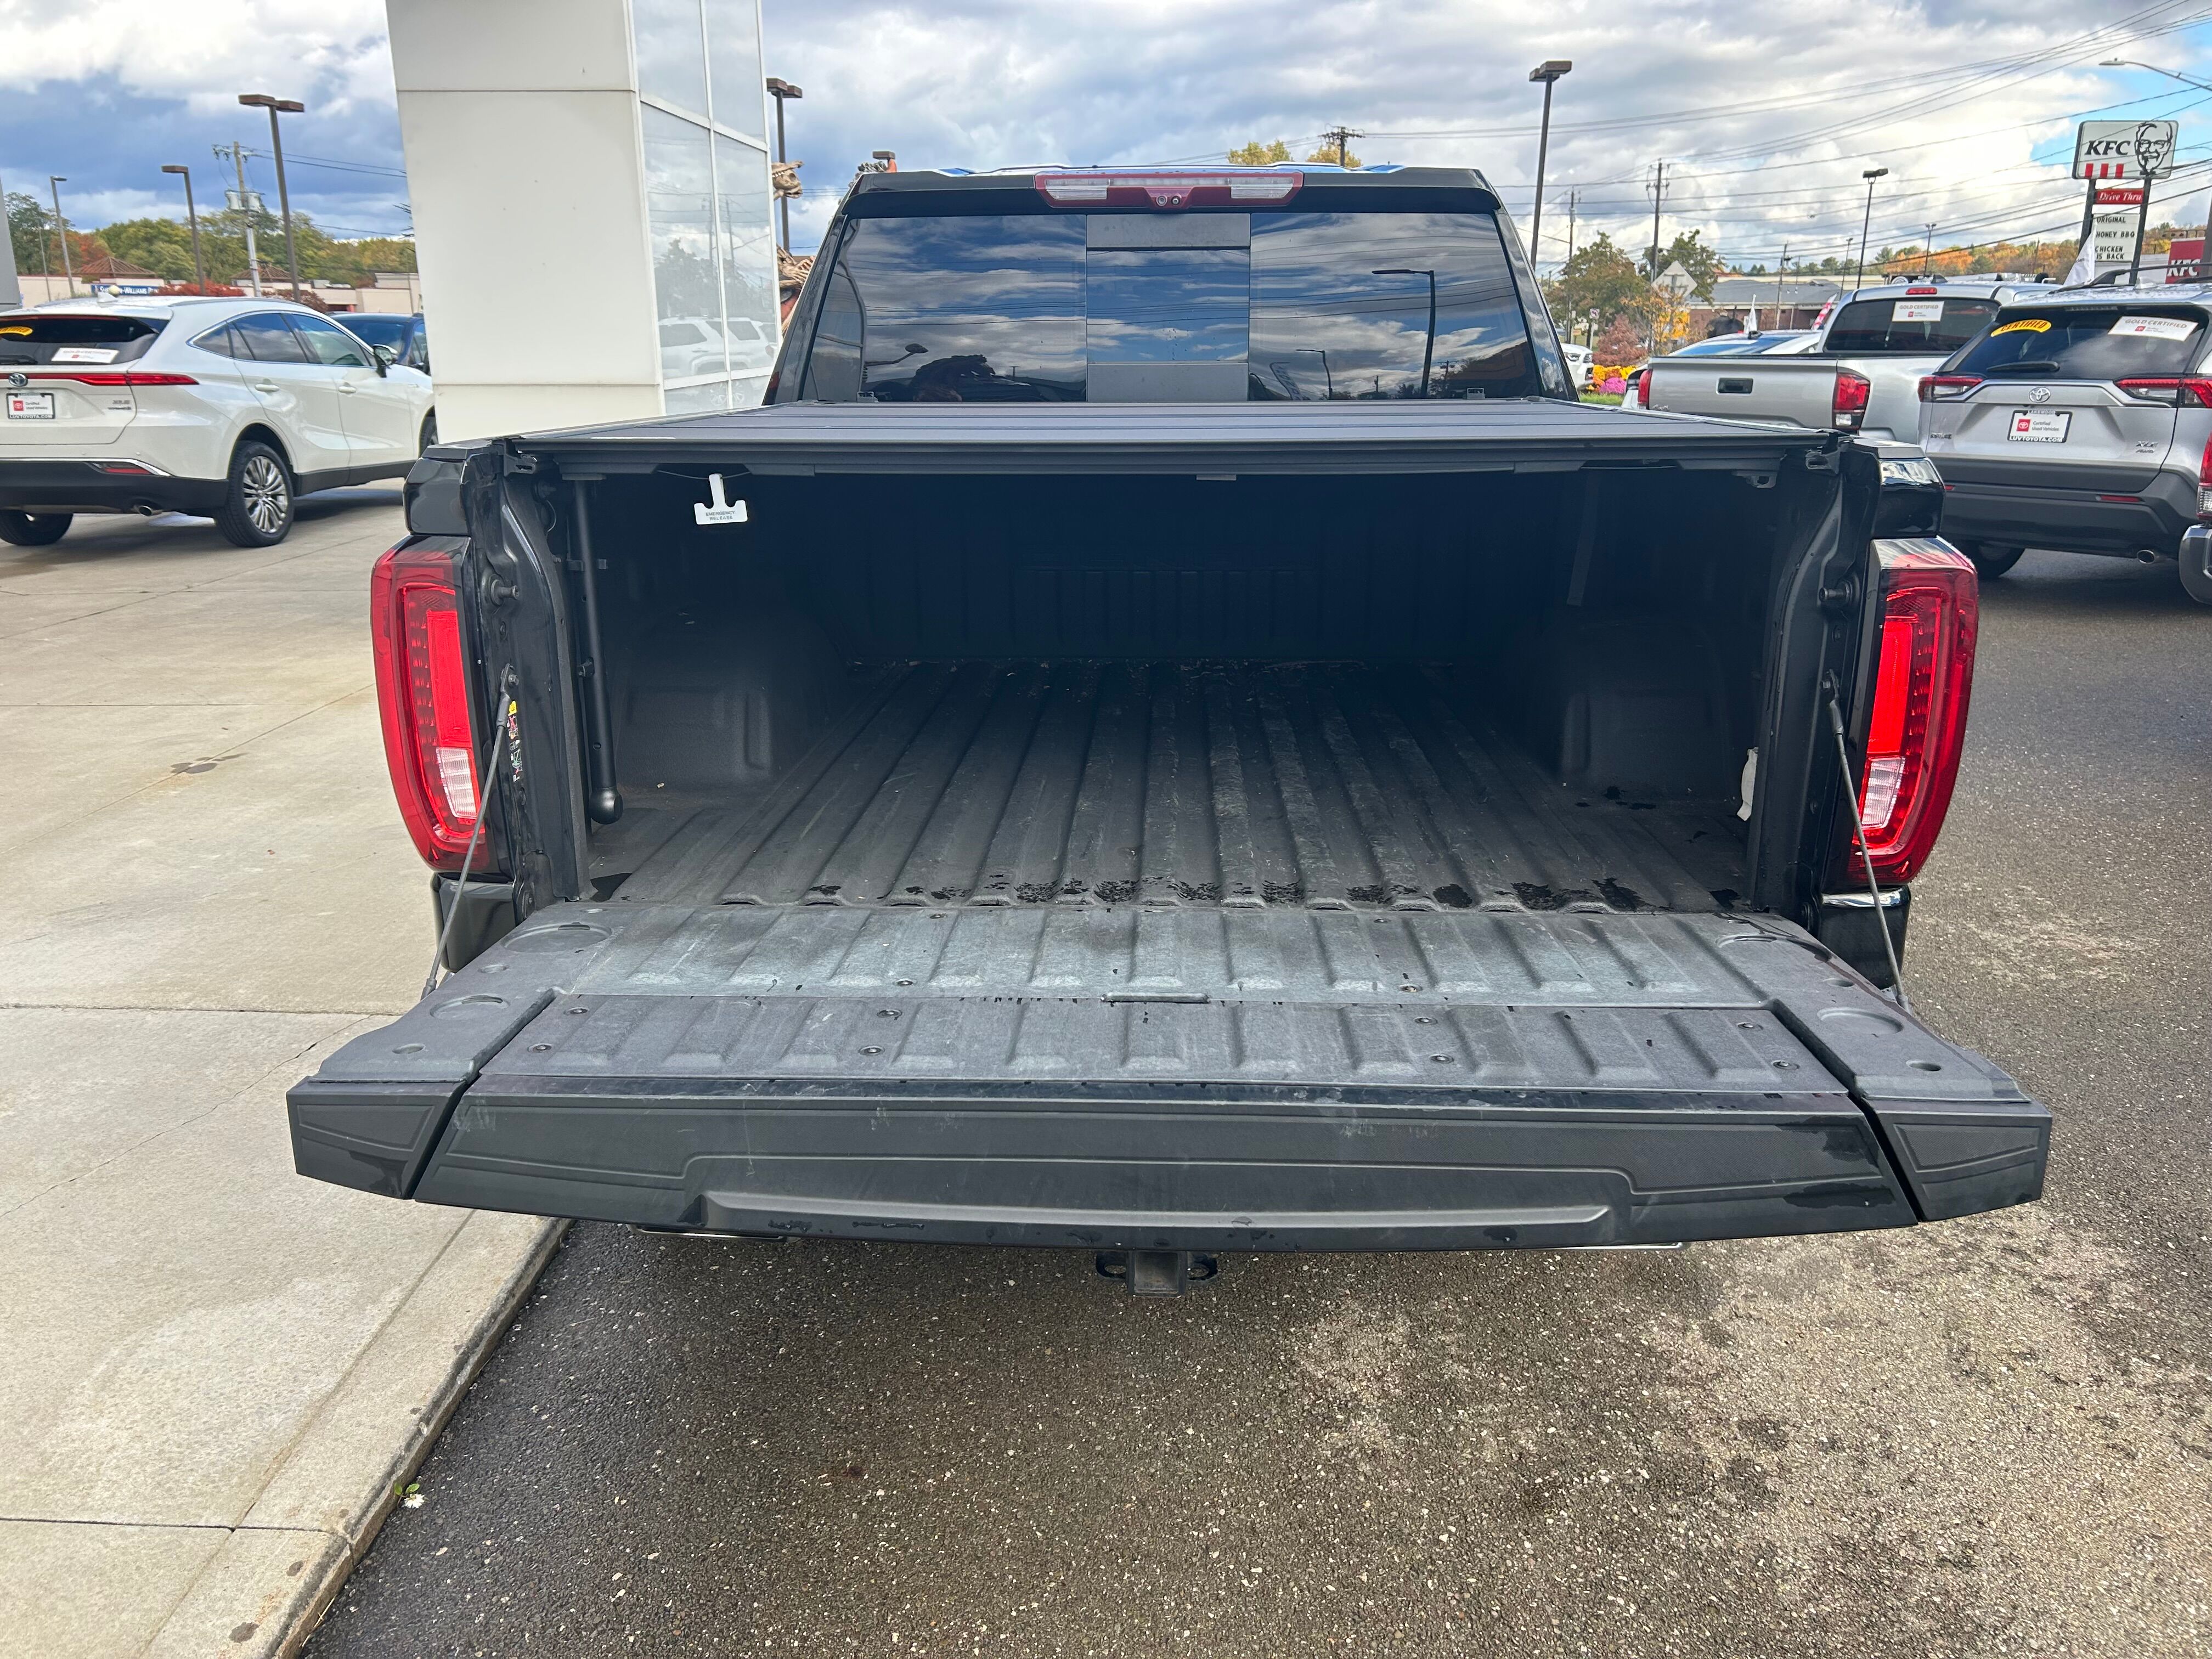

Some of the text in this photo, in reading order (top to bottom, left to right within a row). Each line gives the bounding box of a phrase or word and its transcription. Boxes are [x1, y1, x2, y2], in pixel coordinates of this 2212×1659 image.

[2084, 140, 2130, 155] KFC
[2098, 192, 2142, 201] Drive Thru
[2167, 258, 2201, 276] KFC
[2001, 320, 2047, 331] CERTIFIED
